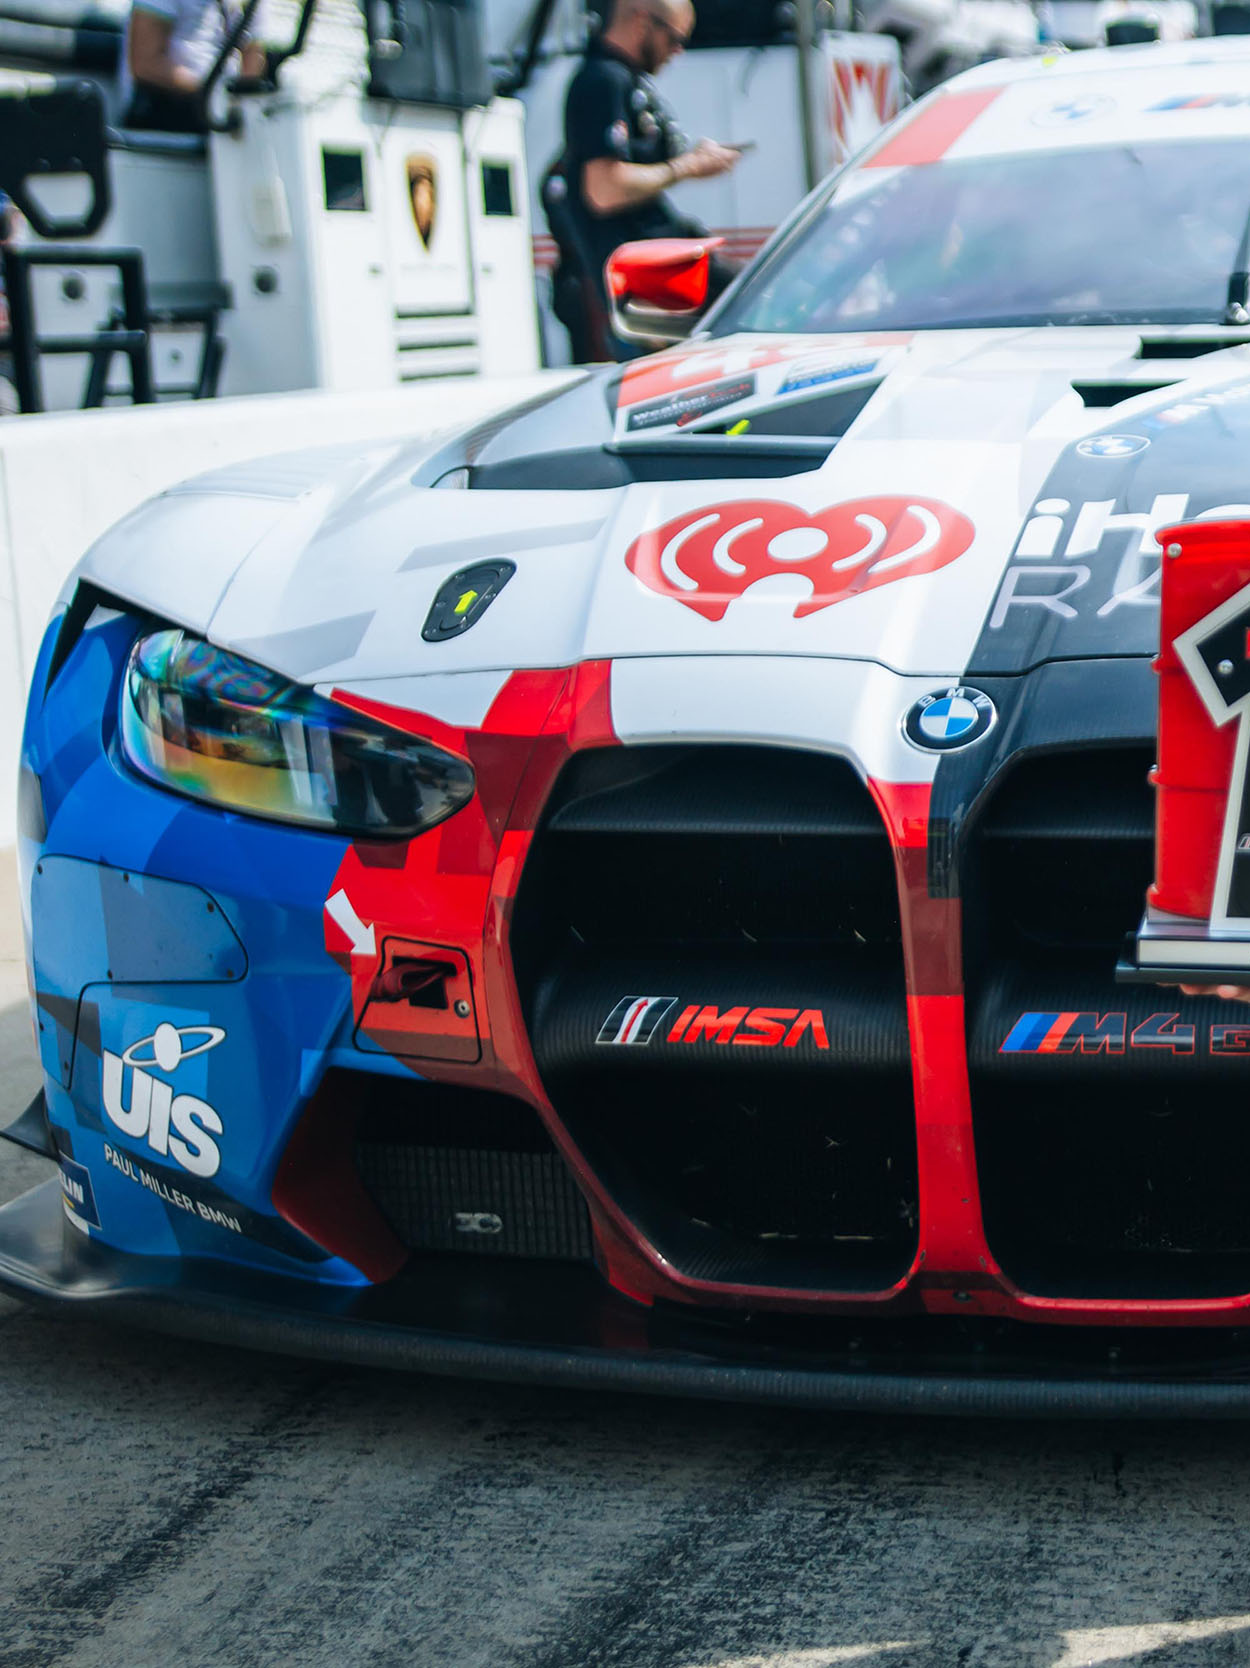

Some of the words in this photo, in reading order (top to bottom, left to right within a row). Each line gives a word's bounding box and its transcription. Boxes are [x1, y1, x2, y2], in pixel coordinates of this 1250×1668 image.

[666, 1004, 830, 1050] IMSA
[998, 1011, 1196, 1056] M4
[103, 1047, 224, 1178] UIS
[103, 1142, 139, 1183] PAUL
[139, 1167, 197, 1215] MILLER
[197, 1201, 243, 1233] BMW
